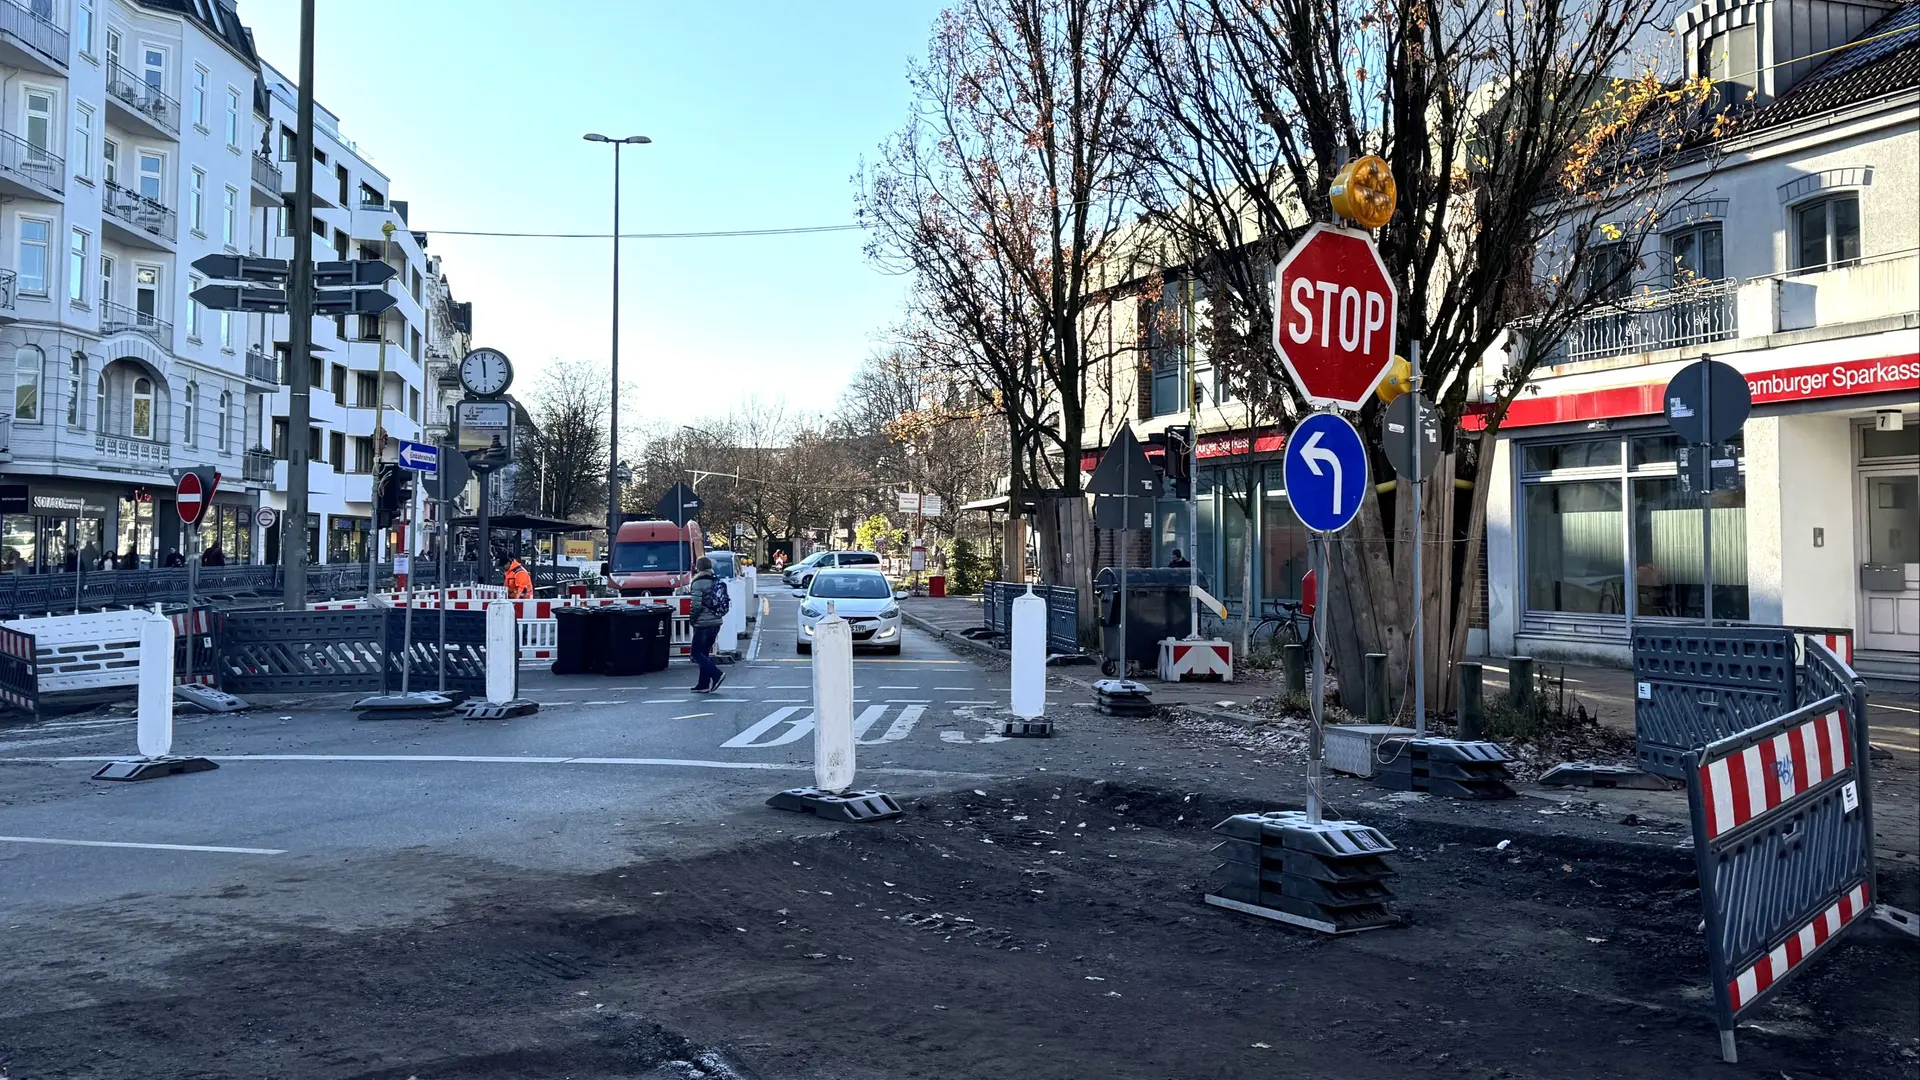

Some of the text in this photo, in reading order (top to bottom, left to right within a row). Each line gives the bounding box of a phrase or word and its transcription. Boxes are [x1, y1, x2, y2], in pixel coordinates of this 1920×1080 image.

[1288, 276, 1385, 355] STOP
[1750, 361, 1919, 395] amburger Sparkass
[1880, 416, 1886, 427] 7
[720, 705, 1012, 747] BUS
